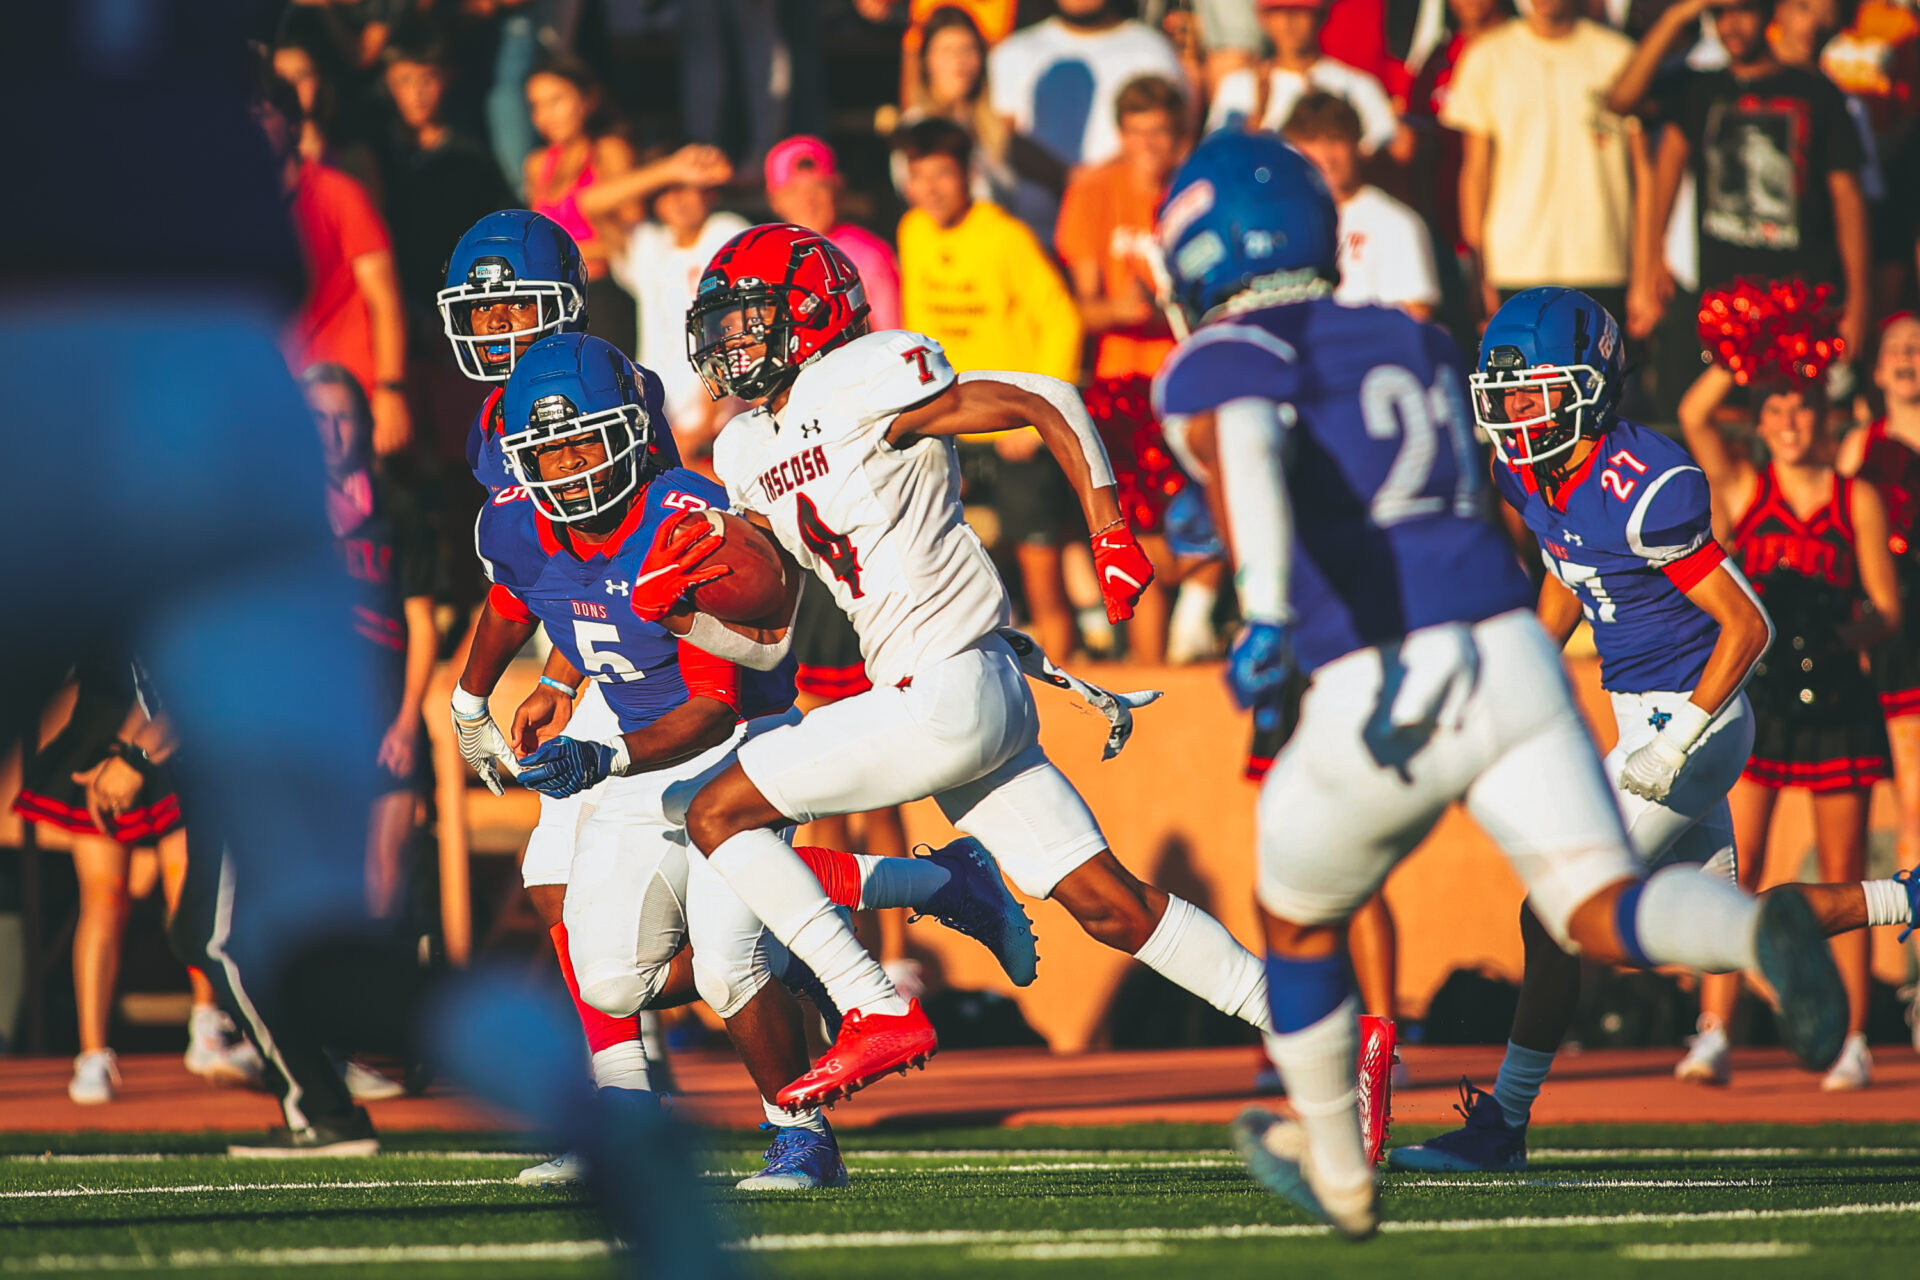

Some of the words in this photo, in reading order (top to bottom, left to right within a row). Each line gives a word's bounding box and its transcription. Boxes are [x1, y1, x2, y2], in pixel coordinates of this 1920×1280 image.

[901, 345, 936, 385] T
[1360, 363, 1479, 528] 21
[662, 490, 711, 513] 5
[759, 445, 830, 504] TASCOSA
[1600, 449, 1649, 503] 27
[796, 491, 866, 600] 4
[570, 600, 608, 619] DONS
[572, 619, 646, 684] 5
